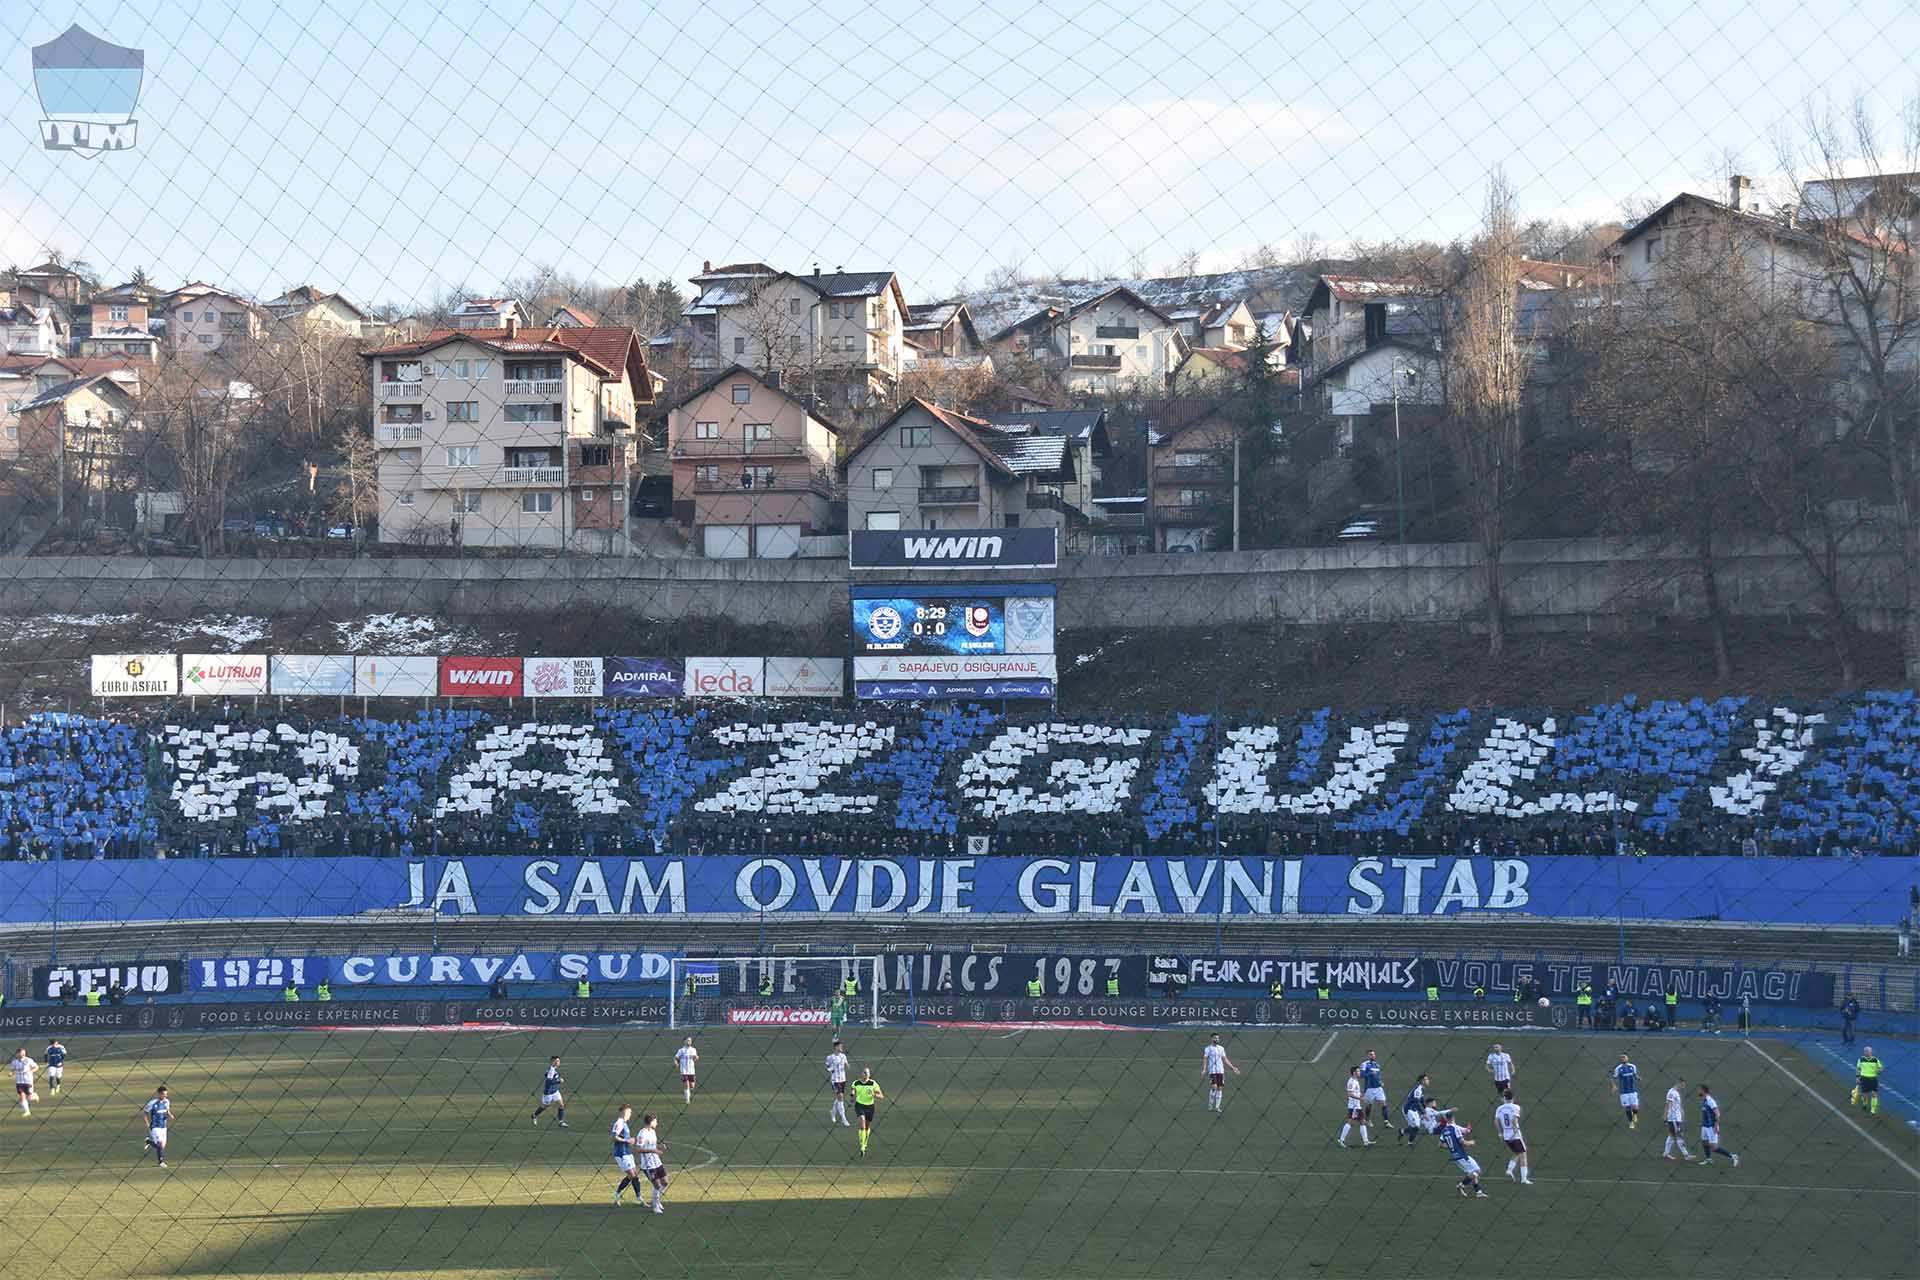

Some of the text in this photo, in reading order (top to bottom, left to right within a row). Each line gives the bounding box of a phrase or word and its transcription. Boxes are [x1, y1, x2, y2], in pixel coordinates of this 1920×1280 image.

[916, 607, 946, 619] 8:29
[573, 660, 593, 669] MENI
[899, 663, 1037, 673] SARAJEVO OSIGURANJE
[208, 665, 262, 678] LUTRIJA
[573, 669, 596, 677] NEMA
[612, 671, 676, 682] ADMIRAL
[694, 669, 753, 692] leda
[399, 856, 1531, 914] JA SAM OVDJE GLAVNI ŠTAB
[202, 958, 305, 987] 1921
[343, 953, 670, 982] CURVA SUD
[736, 954, 1121, 995] THE MANIACS 1987
[1190, 959, 1244, 983] FEAR
[1248, 960, 1273, 982] OF
[1277, 961, 1319, 989] THE
[1326, 958, 1418, 990] MANIACS
[1437, 960, 1801, 1001] VOLE TE MANIJACI
[200, 1012, 238, 1022] FOOD
[257, 1011, 311, 1021] LOUNGE
[318, 1009, 400, 1020] EXPERIENCE
[476, 1008, 514, 1018] FOOD
[533, 1007, 587, 1017] LOUNGE
[593, 1006, 667, 1017] EXPERIENC
[881, 1005, 953, 1015] XPERIENCE
[1033, 1006, 1071, 1016] FOOD
[1091, 1006, 1145, 1016] LOUNGE
[1152, 1007, 1237, 1017] EXPERIENCE
[1319, 1009, 1359, 1018] FOOD
[1380, 1009, 1437, 1020] LOUNGE
[1445, 1010, 1533, 1021] EXPERIENCE
[40, 1014, 122, 1026] EXPERIENCE
